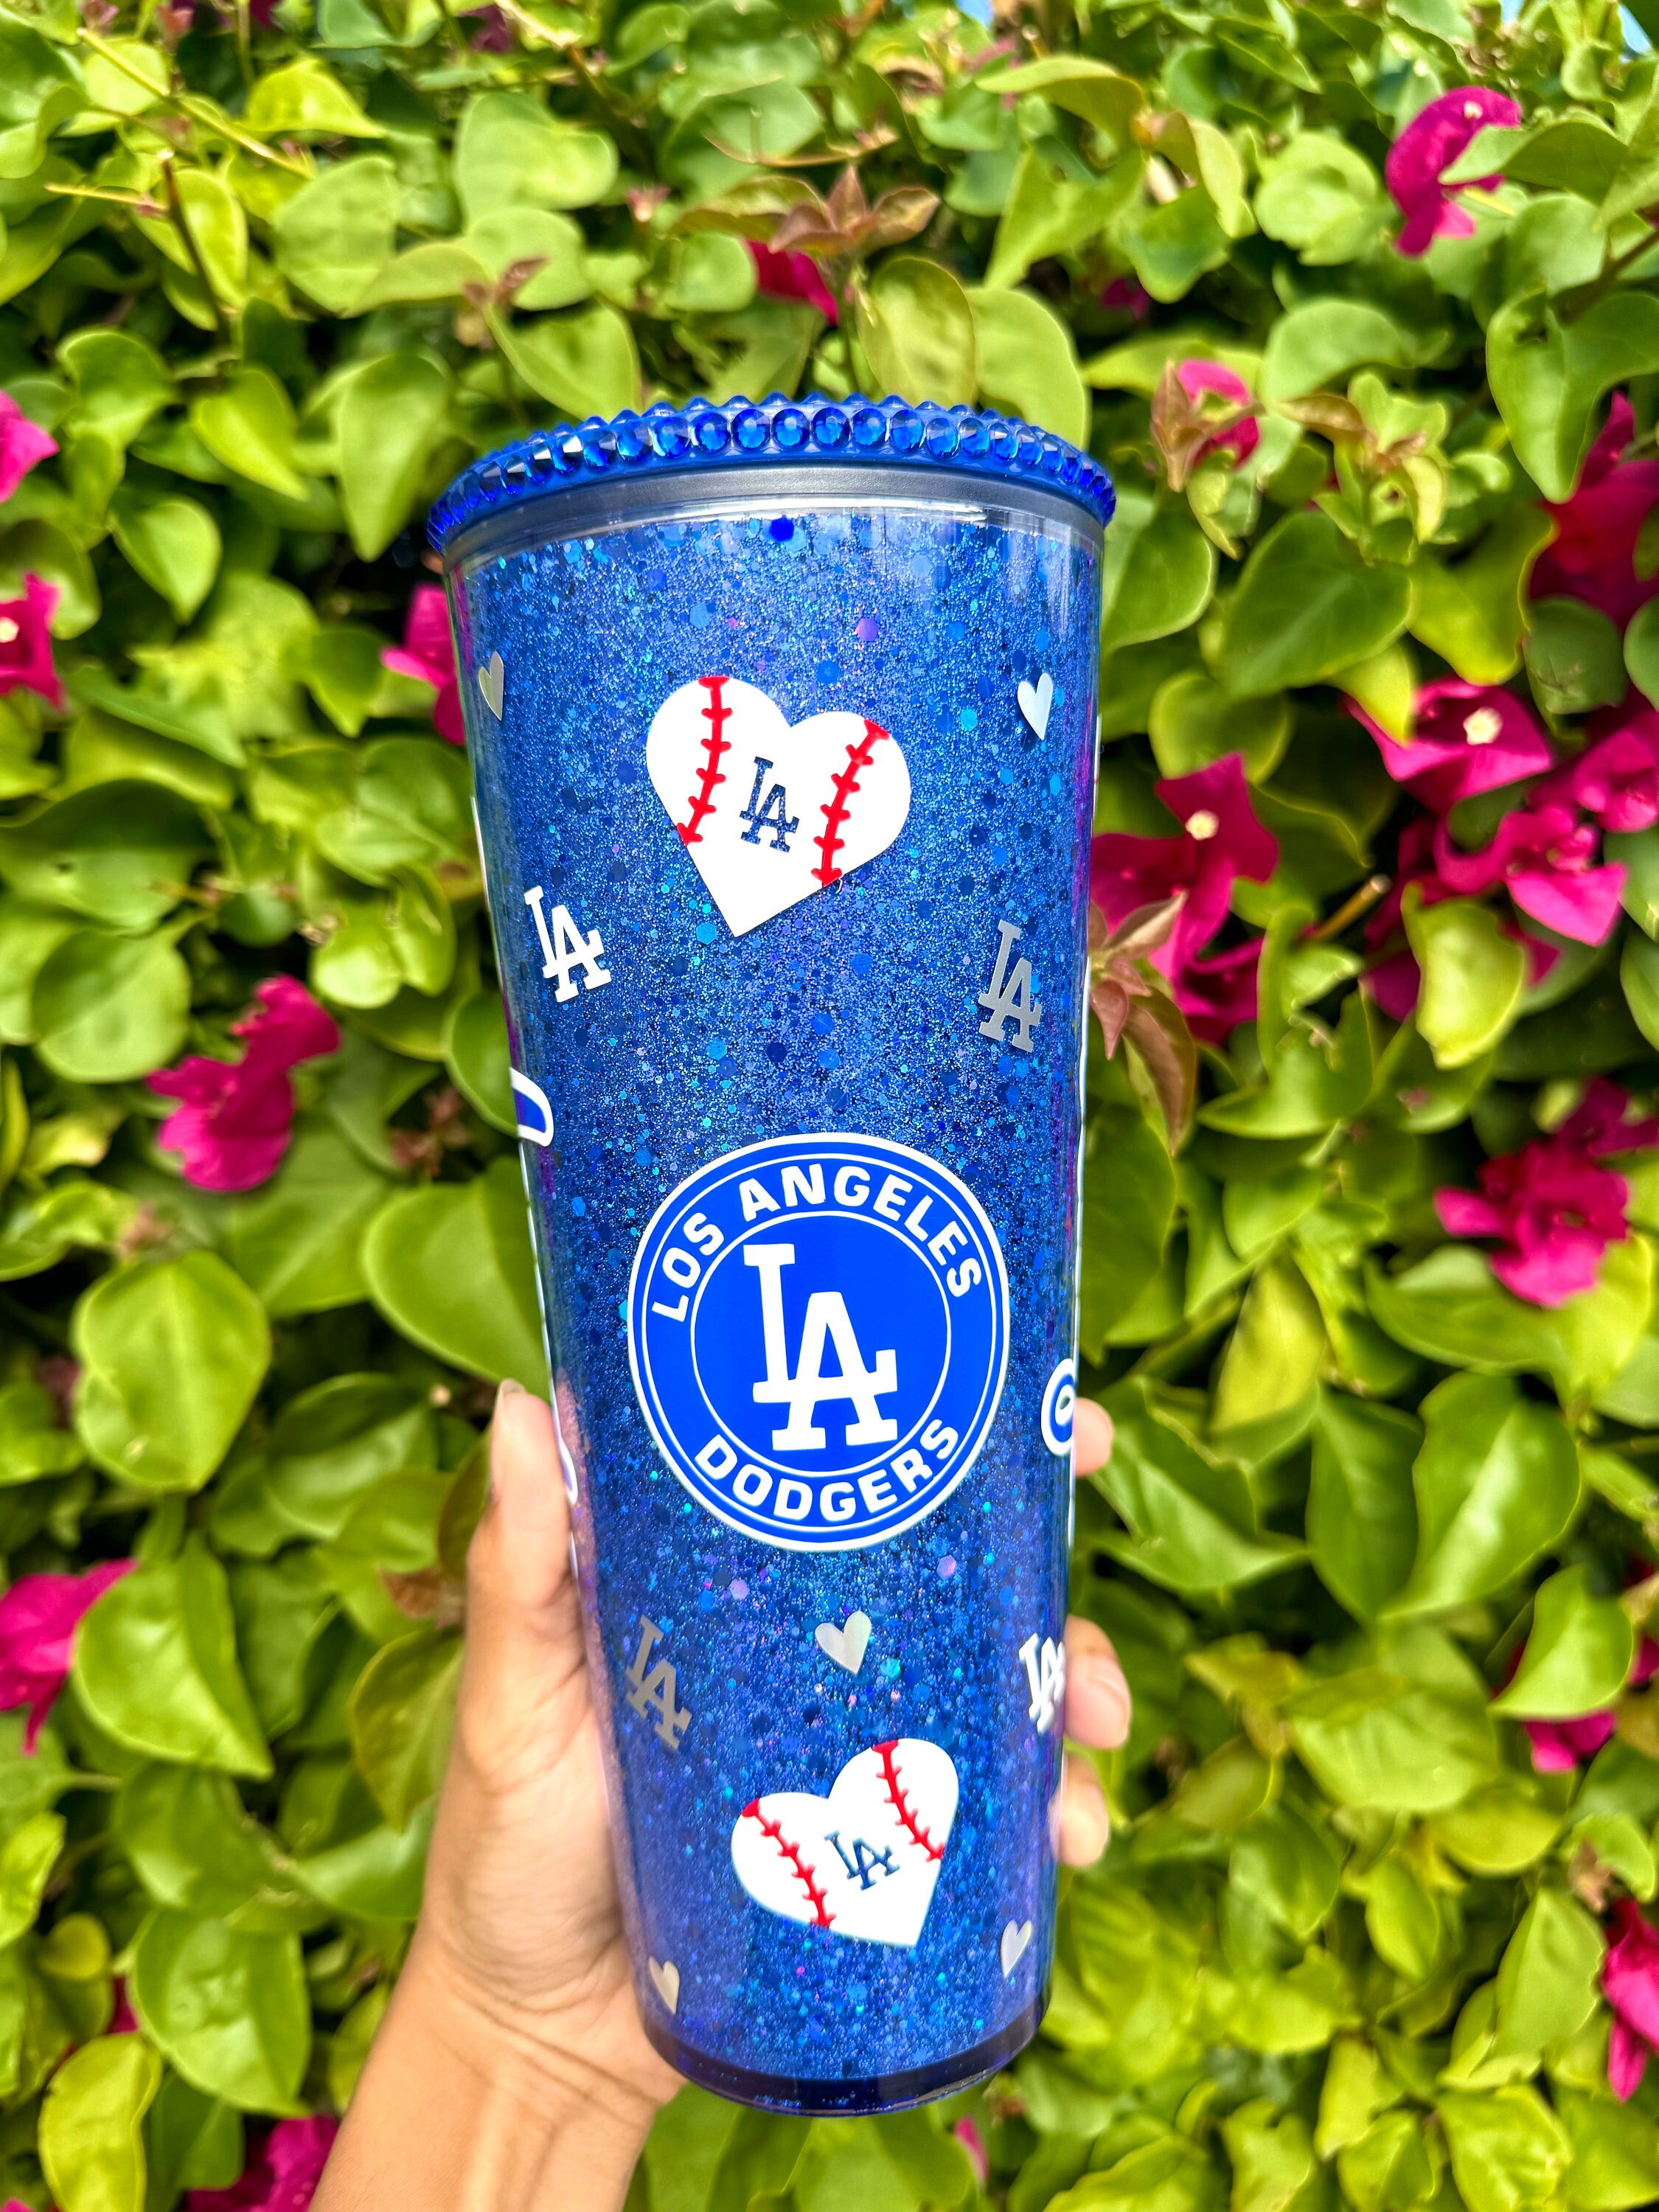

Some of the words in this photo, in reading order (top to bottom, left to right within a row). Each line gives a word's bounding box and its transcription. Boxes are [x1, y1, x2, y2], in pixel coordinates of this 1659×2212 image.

[740, 757, 799, 852] LA
[525, 886, 611, 1001] LA
[979, 920, 1040, 1051] LA
[653, 1220, 725, 1321] LOS
[740, 1164, 982, 1298] ANGELES
[744, 1244, 897, 1450] LA
[695, 1419, 959, 1520] DODGERS
[626, 1616, 692, 1750] LA
[825, 1831, 900, 1890] LA
